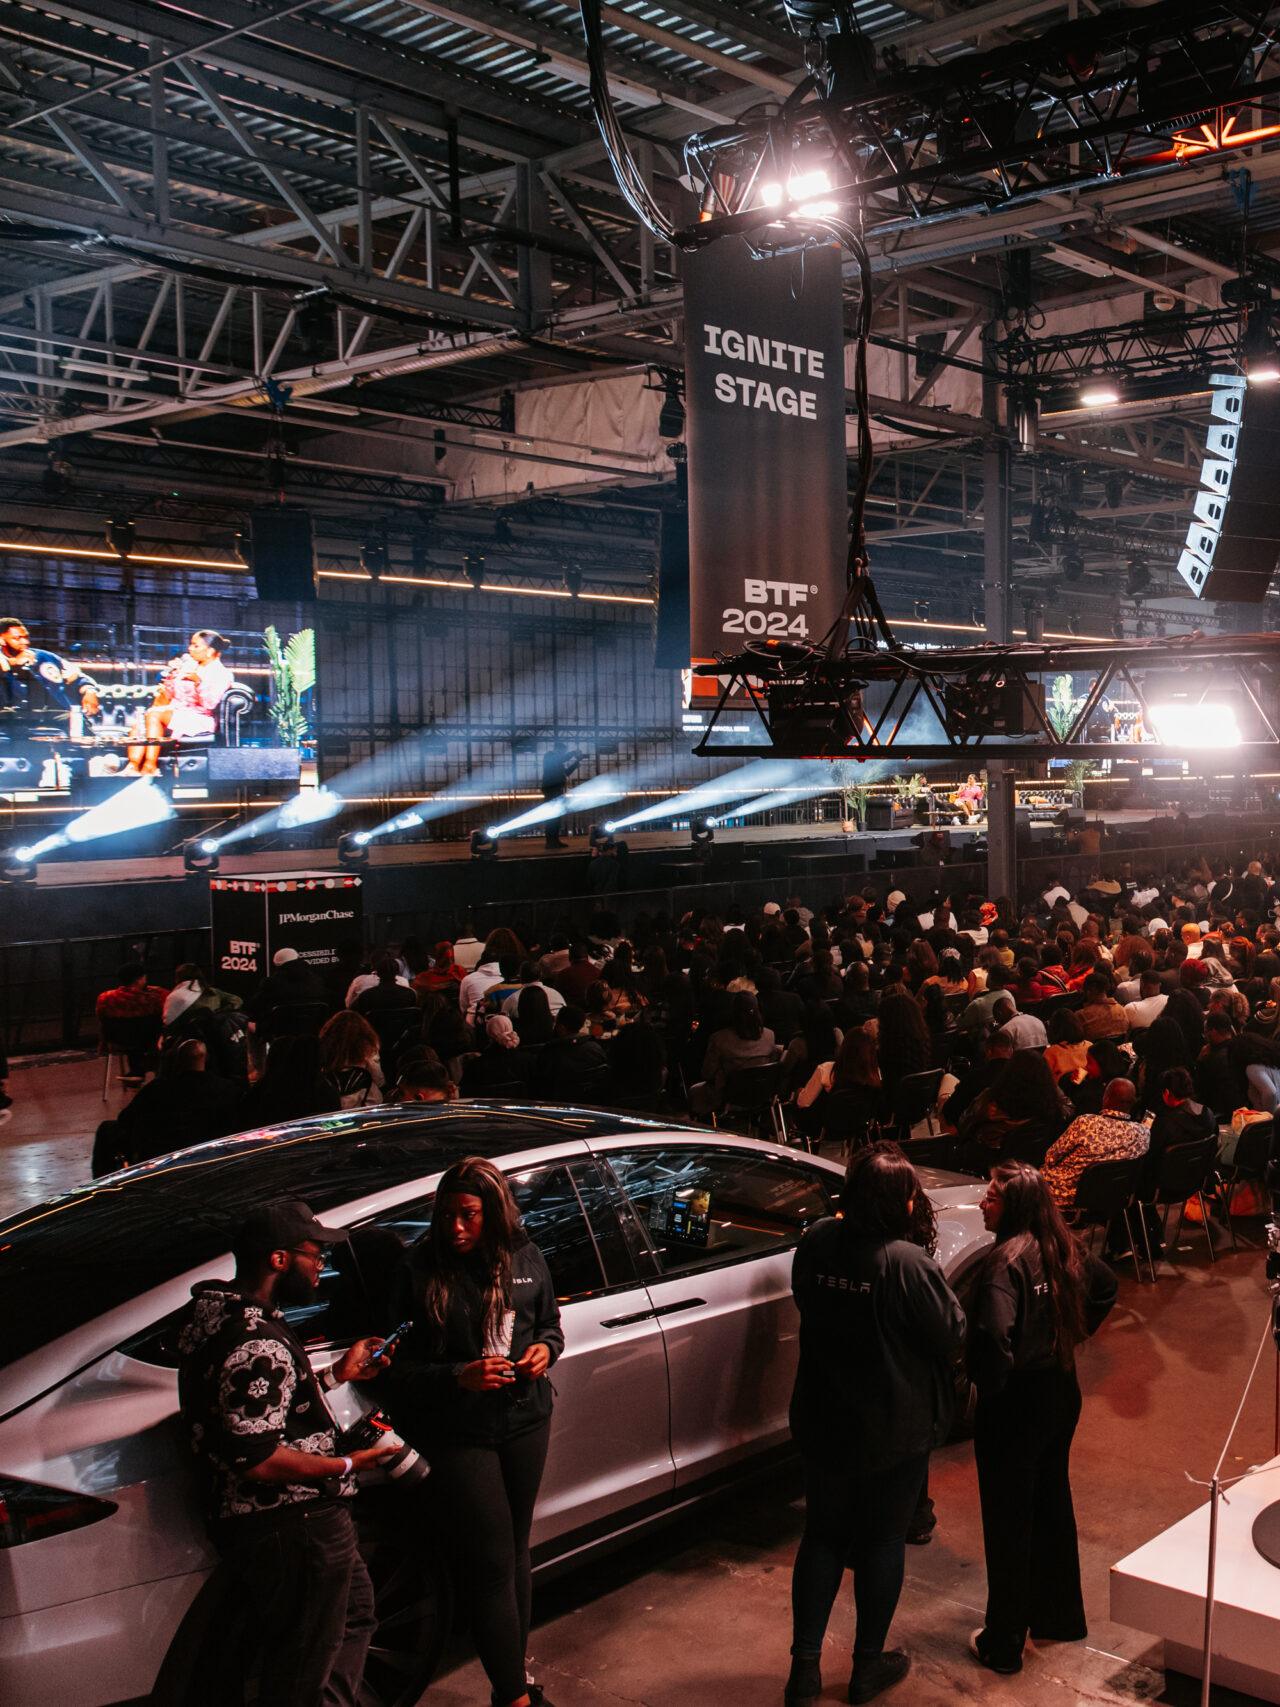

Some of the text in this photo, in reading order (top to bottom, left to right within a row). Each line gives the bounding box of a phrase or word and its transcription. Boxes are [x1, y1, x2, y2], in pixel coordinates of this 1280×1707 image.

[703, 323, 825, 379] IGNITE
[714, 372, 817, 420] STAGE
[722, 608, 809, 638] 2024
[279, 910, 354, 925] JPMorganChase
[221, 956, 257, 972] 2024
[816, 1274, 871, 1294] TESLA
